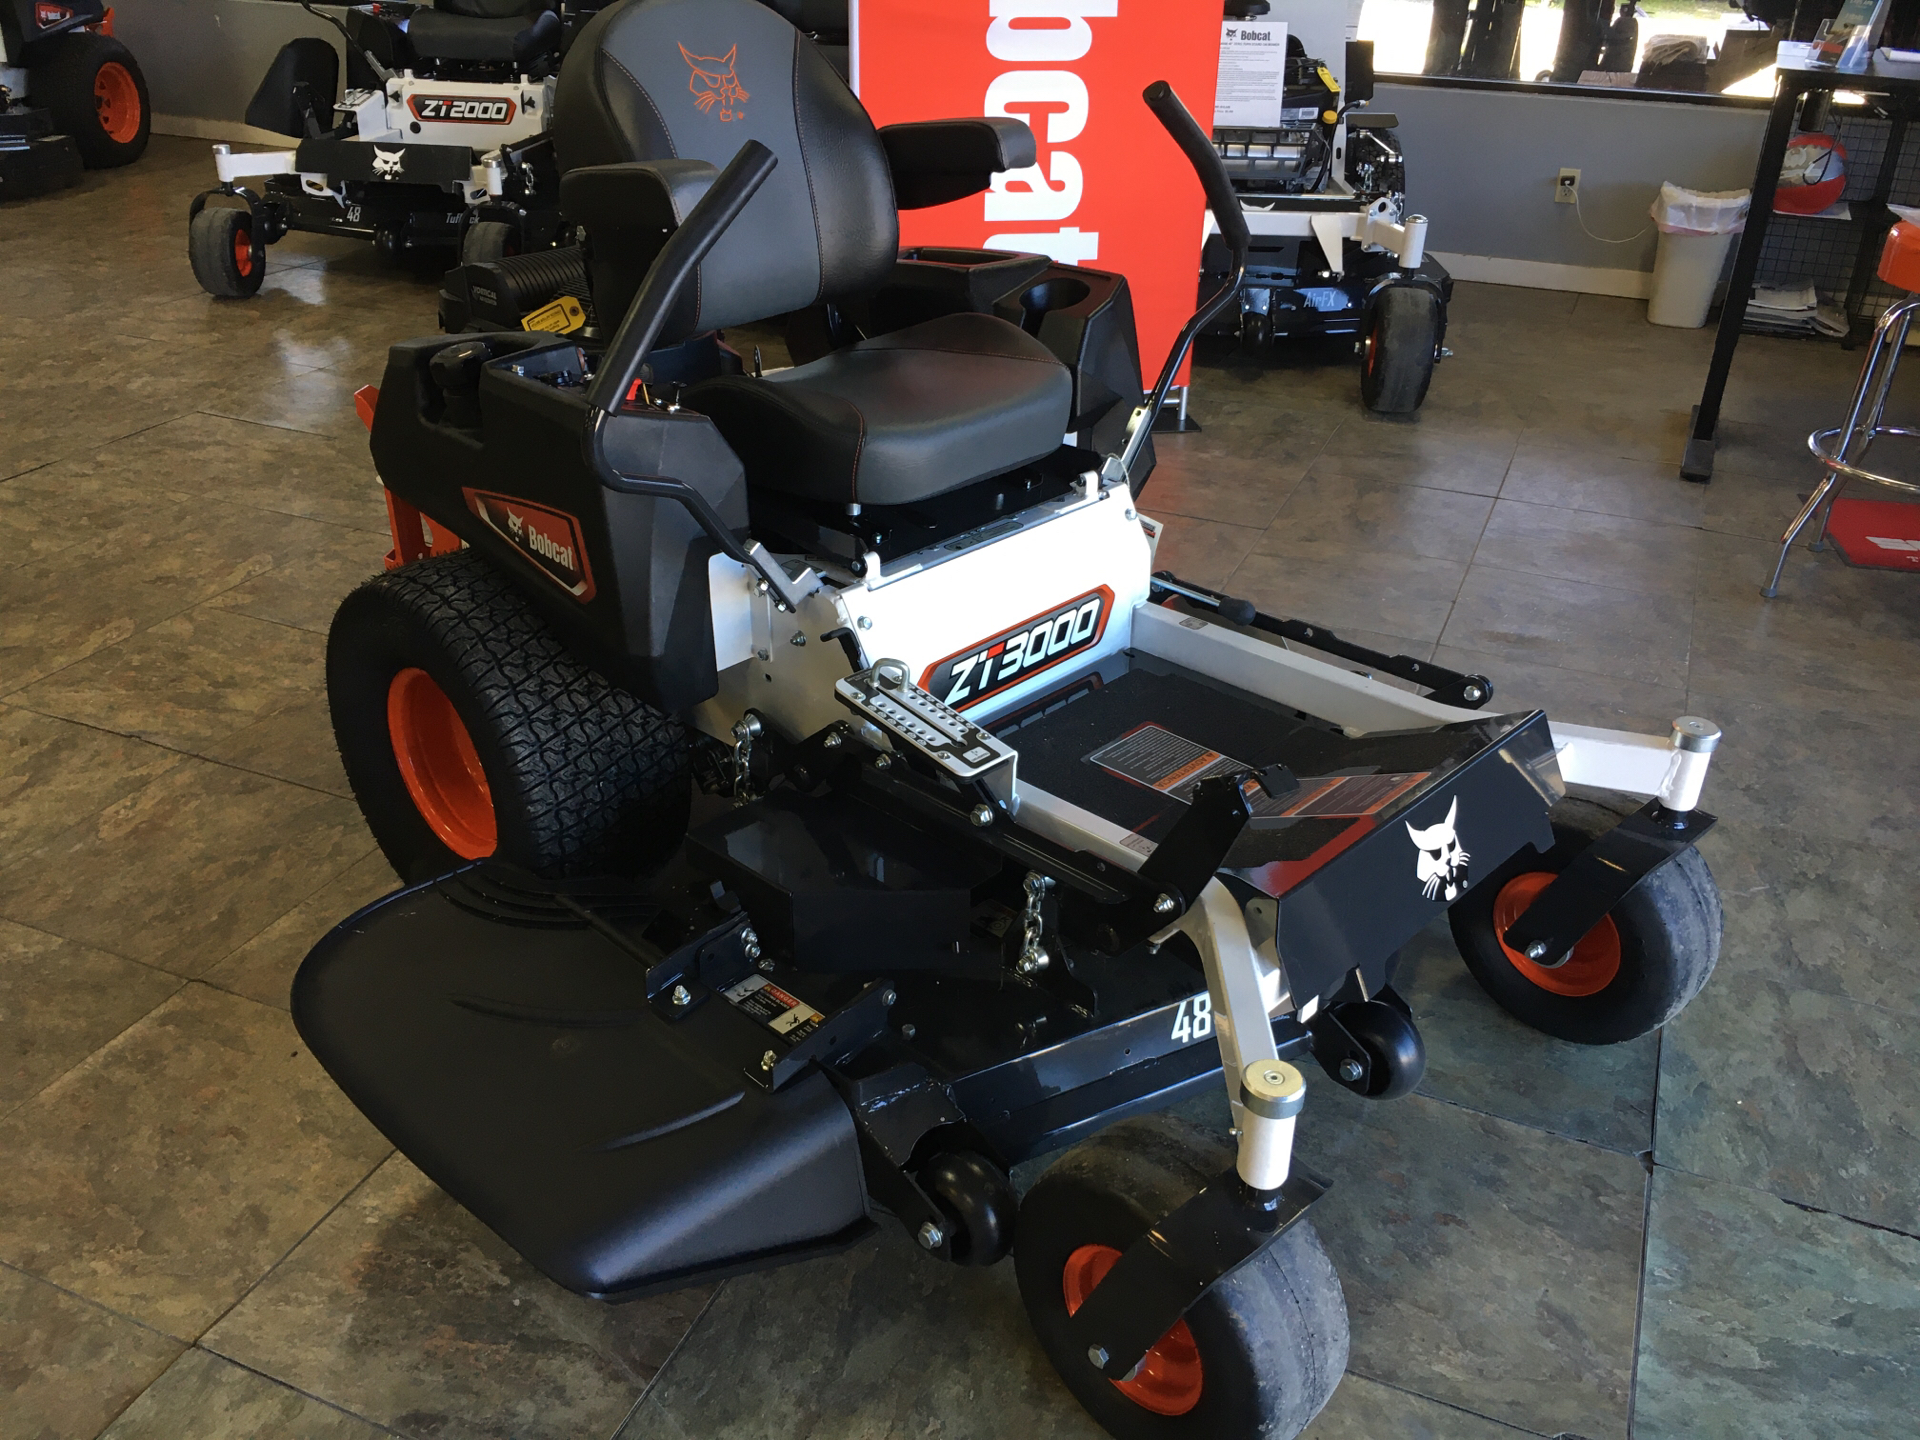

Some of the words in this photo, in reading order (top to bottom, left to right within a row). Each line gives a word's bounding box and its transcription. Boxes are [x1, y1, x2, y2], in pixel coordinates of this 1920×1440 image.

[1241, 30, 1271, 41] Bobcat
[421, 100, 508, 119] ZT2000
[346, 206, 362, 222] 48
[445, 212, 480, 225] Tuffck
[1303, 290, 1337, 308] AirFX
[528, 524, 574, 571] Bobcat
[944, 598, 1100, 706] ZT3000
[769, 988, 799, 1008] DANGER
